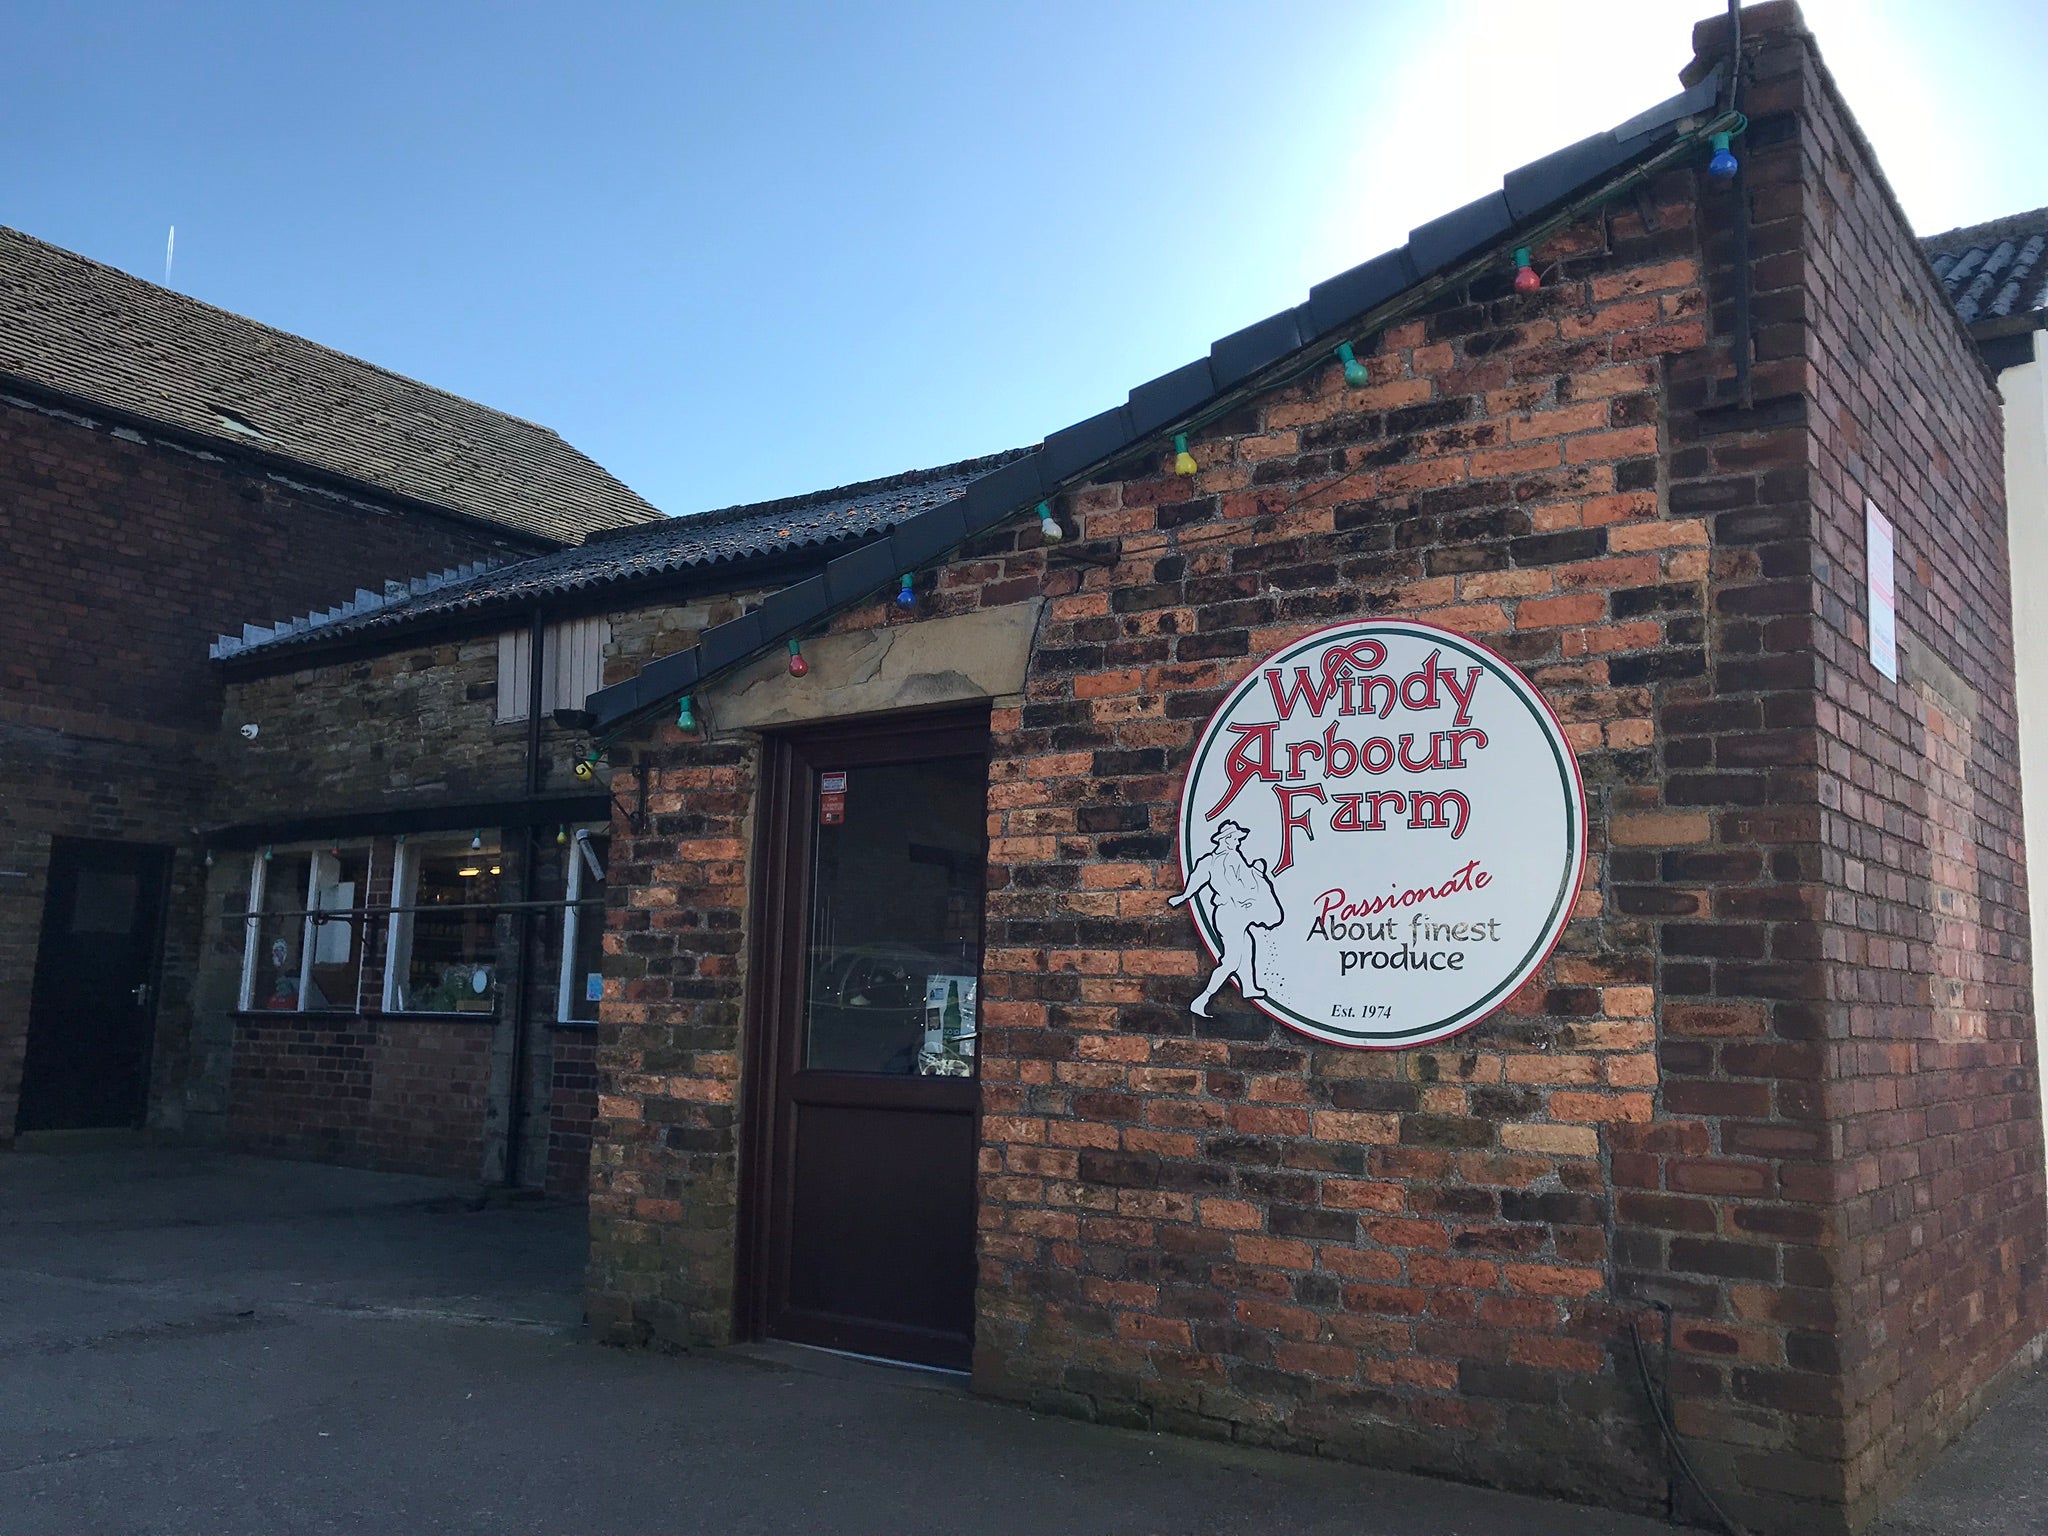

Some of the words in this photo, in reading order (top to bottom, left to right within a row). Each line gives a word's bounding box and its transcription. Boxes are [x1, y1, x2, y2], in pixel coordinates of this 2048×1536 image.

[1264, 639, 1483, 726] Windy
[1206, 721, 1488, 821] Arbour
[1271, 783, 1470, 877] Farm
[1314, 860, 1493, 926] Passionate
[1307, 915, 1397, 941] About
[1409, 913, 1501, 946] finest
[1339, 943, 1464, 975] produce
[1331, 1004, 1355, 1018] Est.
[1361, 1005, 1392, 1019] 1974
